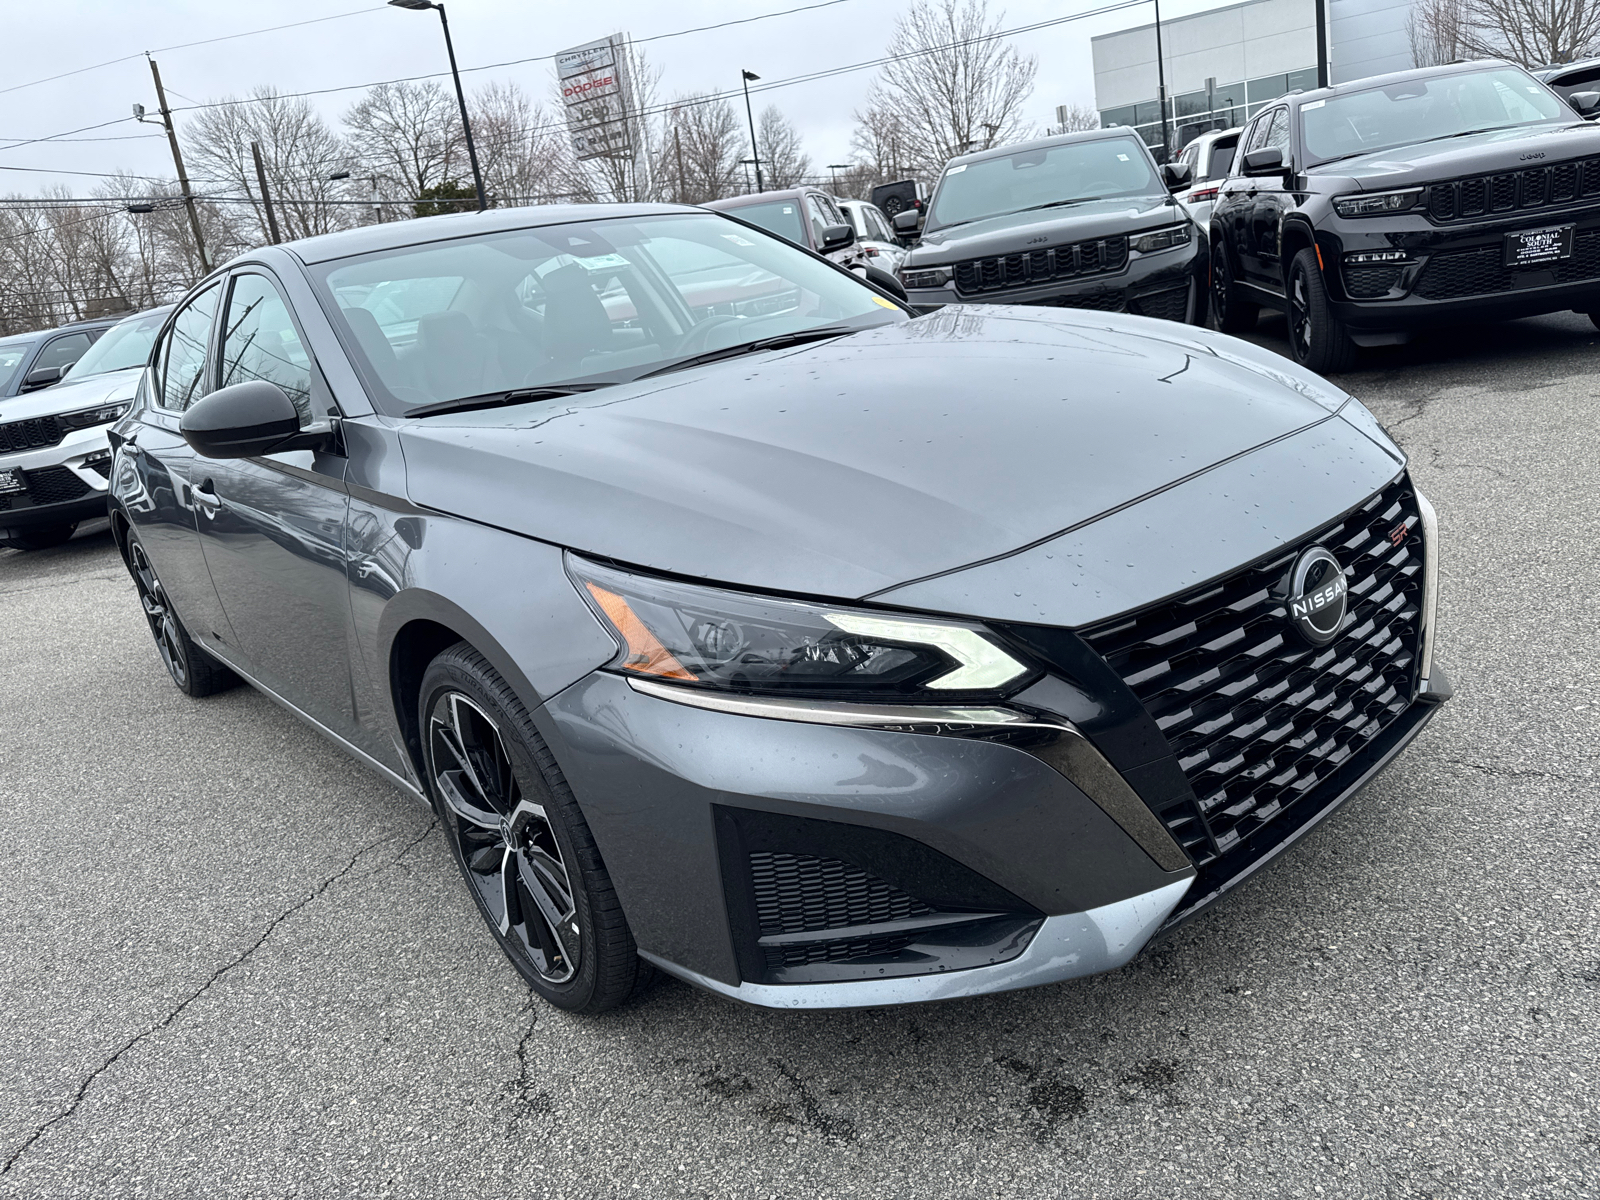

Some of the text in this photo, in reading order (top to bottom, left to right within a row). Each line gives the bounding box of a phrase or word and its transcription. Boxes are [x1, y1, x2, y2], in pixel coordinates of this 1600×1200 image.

[559, 47, 605, 64] CHRYSLER
[564, 77, 612, 97] DODGE
[576, 105, 609, 121] Jeep
[1520, 232, 1560, 243] COLONIAL
[1526, 239, 1552, 247] SOUTH
[1390, 523, 1408, 547] SR
[1292, 574, 1348, 617] NISSAN
[459, 672, 504, 719] TURANZA
[578, 888, 594, 987] BRIDGESTONE
